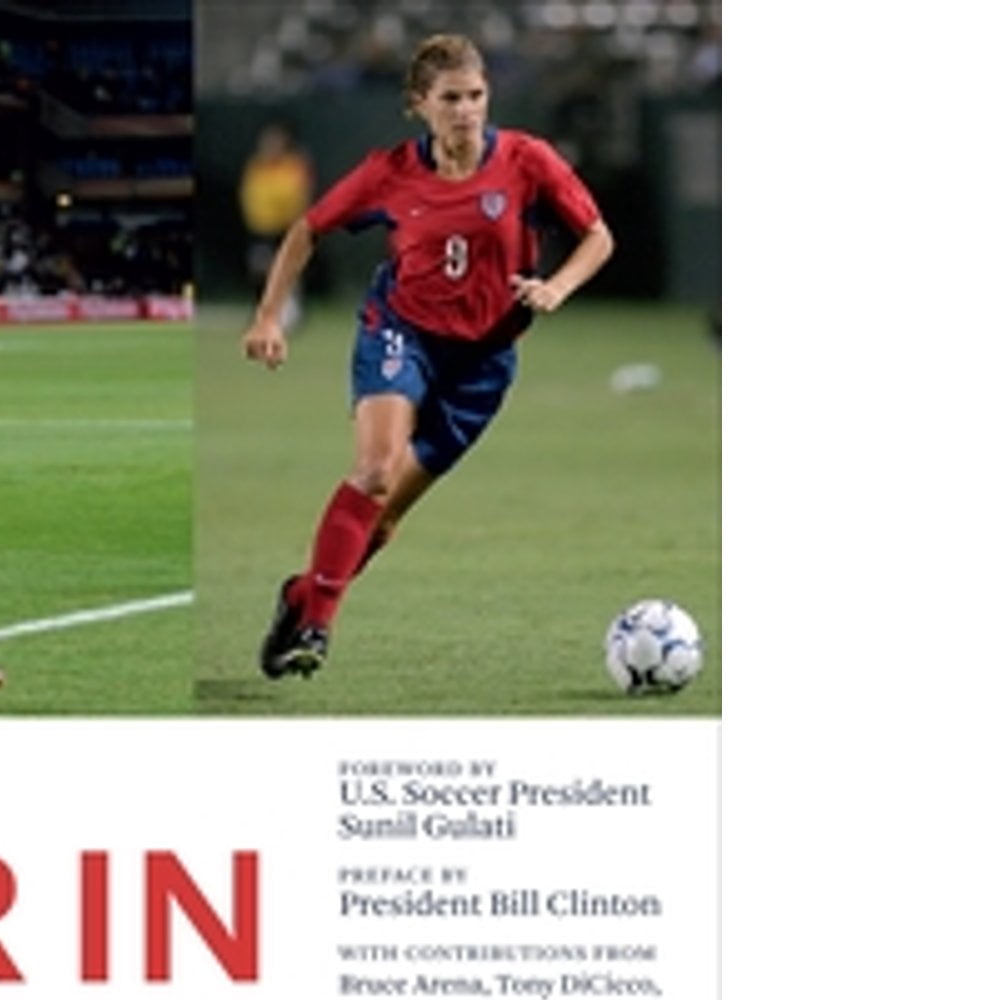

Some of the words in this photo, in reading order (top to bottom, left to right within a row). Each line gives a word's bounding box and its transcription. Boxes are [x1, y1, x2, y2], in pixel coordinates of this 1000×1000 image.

[444, 233, 469, 281] 9
[339, 761, 462, 776] FOREWORD
[470, 761, 495, 776] BY
[340, 781, 396, 806] U.S.
[402, 781, 501, 806] Soccer
[509, 779, 650, 806] President
[339, 812, 416, 840] Sunil
[422, 811, 516, 840] Gulati
[339, 868, 431, 883] PREFACE
[441, 868, 467, 883] BY
[340, 890, 482, 917] President
[491, 889, 540, 917] Bill
[546, 889, 662, 917] Clinton
[78, 849, 261, 985] IN
[338, 945, 397, 961] WITH
[403, 945, 587, 961] CONTRIBUTIONS
[593, 945, 657, 961] FROM
[340, 974, 408, 995] Bruce
[413, 975, 492, 997] Arena,
[496, 974, 554, 1000] Tony
